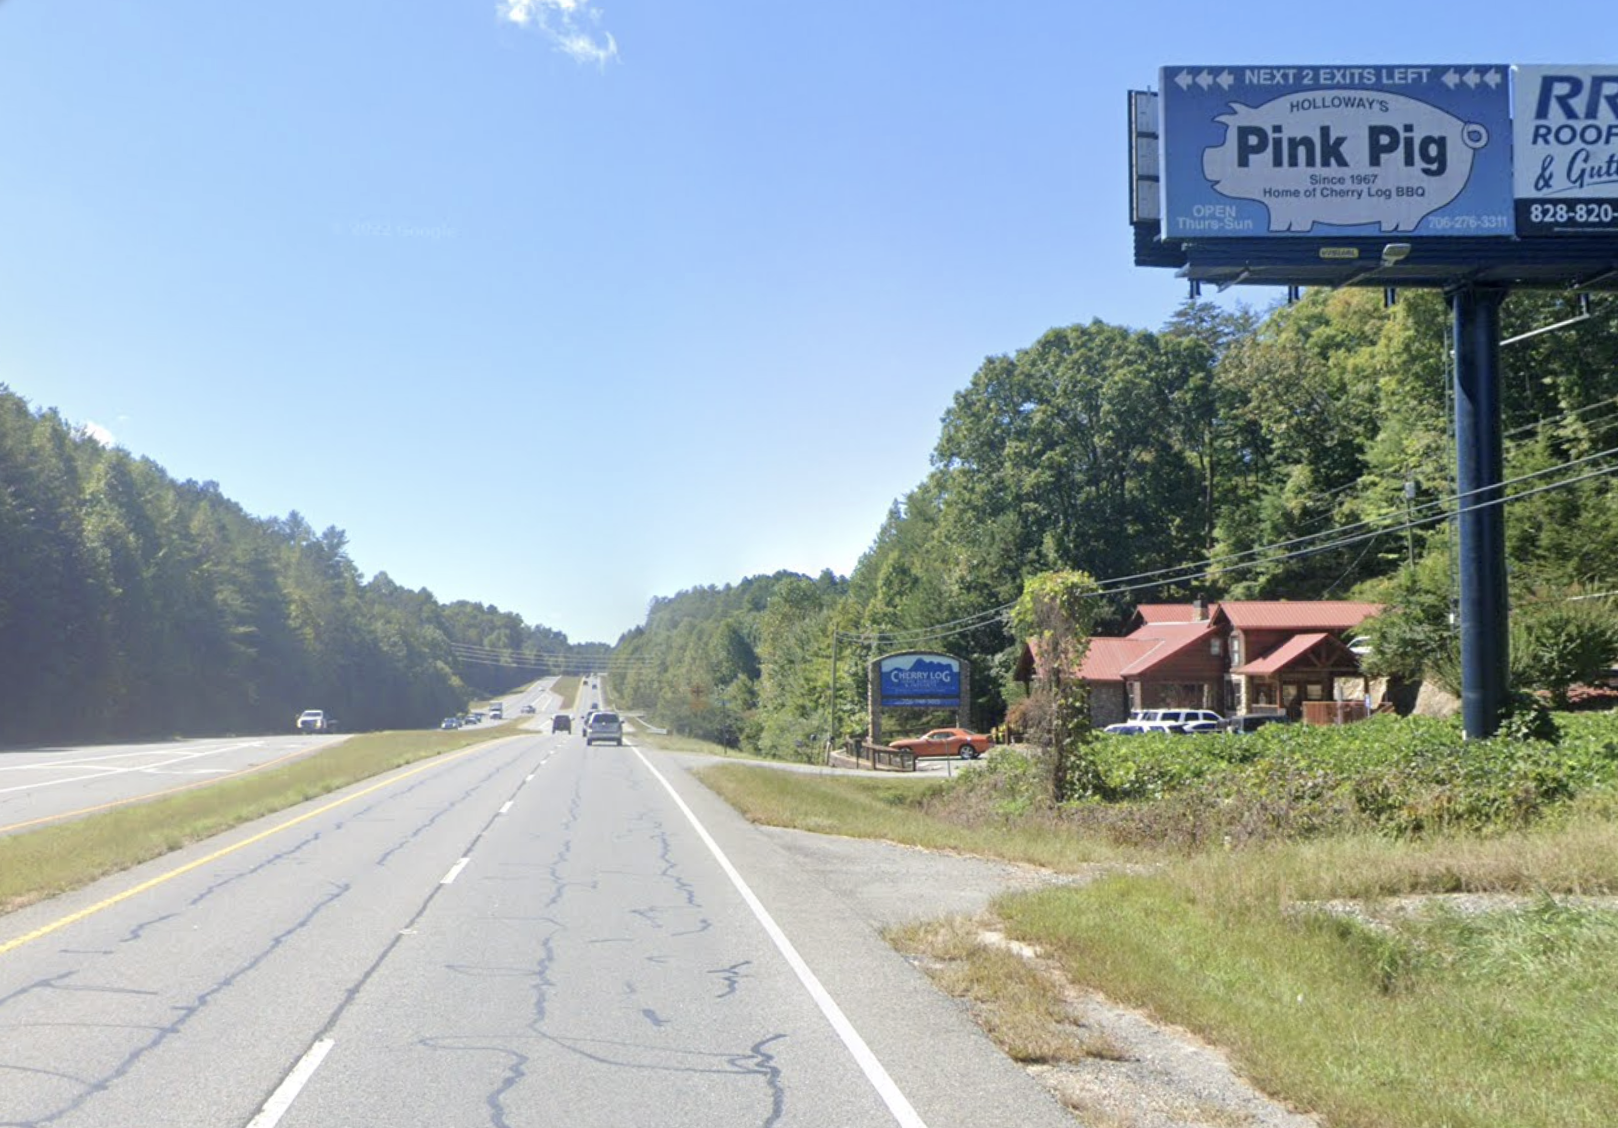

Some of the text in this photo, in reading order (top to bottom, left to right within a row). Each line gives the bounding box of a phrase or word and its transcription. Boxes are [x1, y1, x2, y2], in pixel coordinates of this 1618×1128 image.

[1244, 67, 1432, 85] NEXT 2 EXITS LEFT
[1289, 95, 1390, 112] HOLLOWAY'S
[1236, 123, 1448, 177] Pink Pig
[1309, 174, 1378, 186] Since 1967
[1533, 154, 1554, 193] &
[1263, 186, 1426, 200] Home of Cherry Log BBQ
[1192, 205, 1237, 218] OPEN
[1176, 217, 1254, 231] Thurs-Sun
[1428, 215, 1508, 230] 706-276-3311
[891, 670, 951, 682] CHERRY LOG
